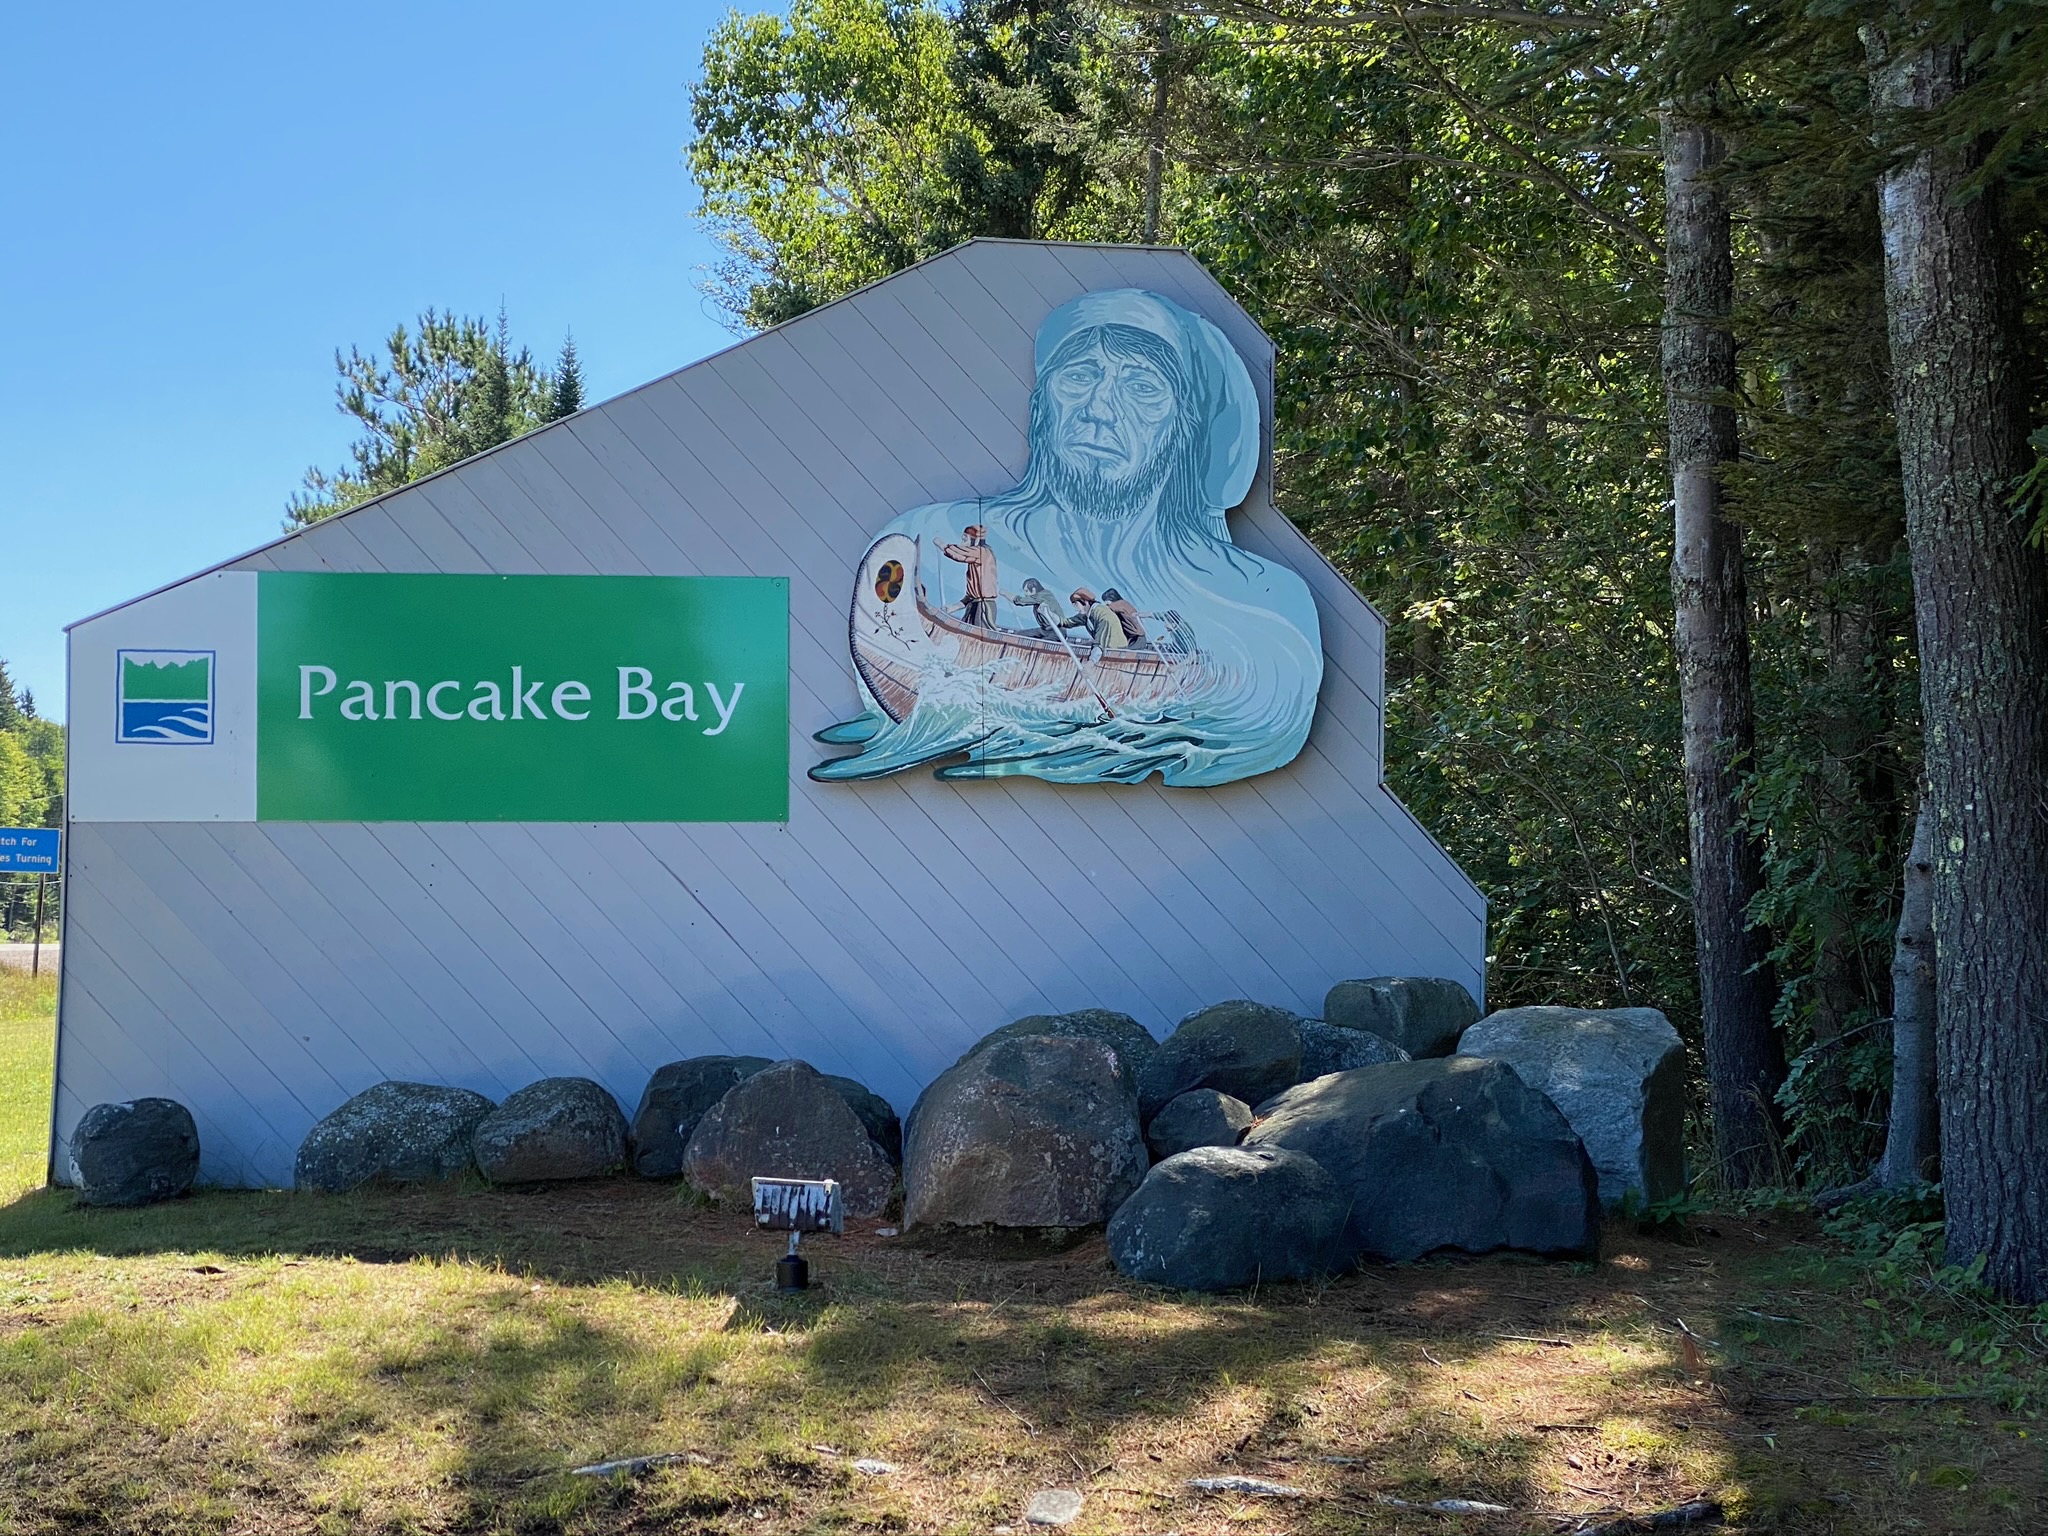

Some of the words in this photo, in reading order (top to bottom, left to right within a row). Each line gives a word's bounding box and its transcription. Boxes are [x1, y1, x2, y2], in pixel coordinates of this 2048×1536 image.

[298, 665, 592, 721] Pancake
[616, 666, 745, 735] Bay
[21, 836, 38, 847] For
[15, 853, 52, 866] Turning
